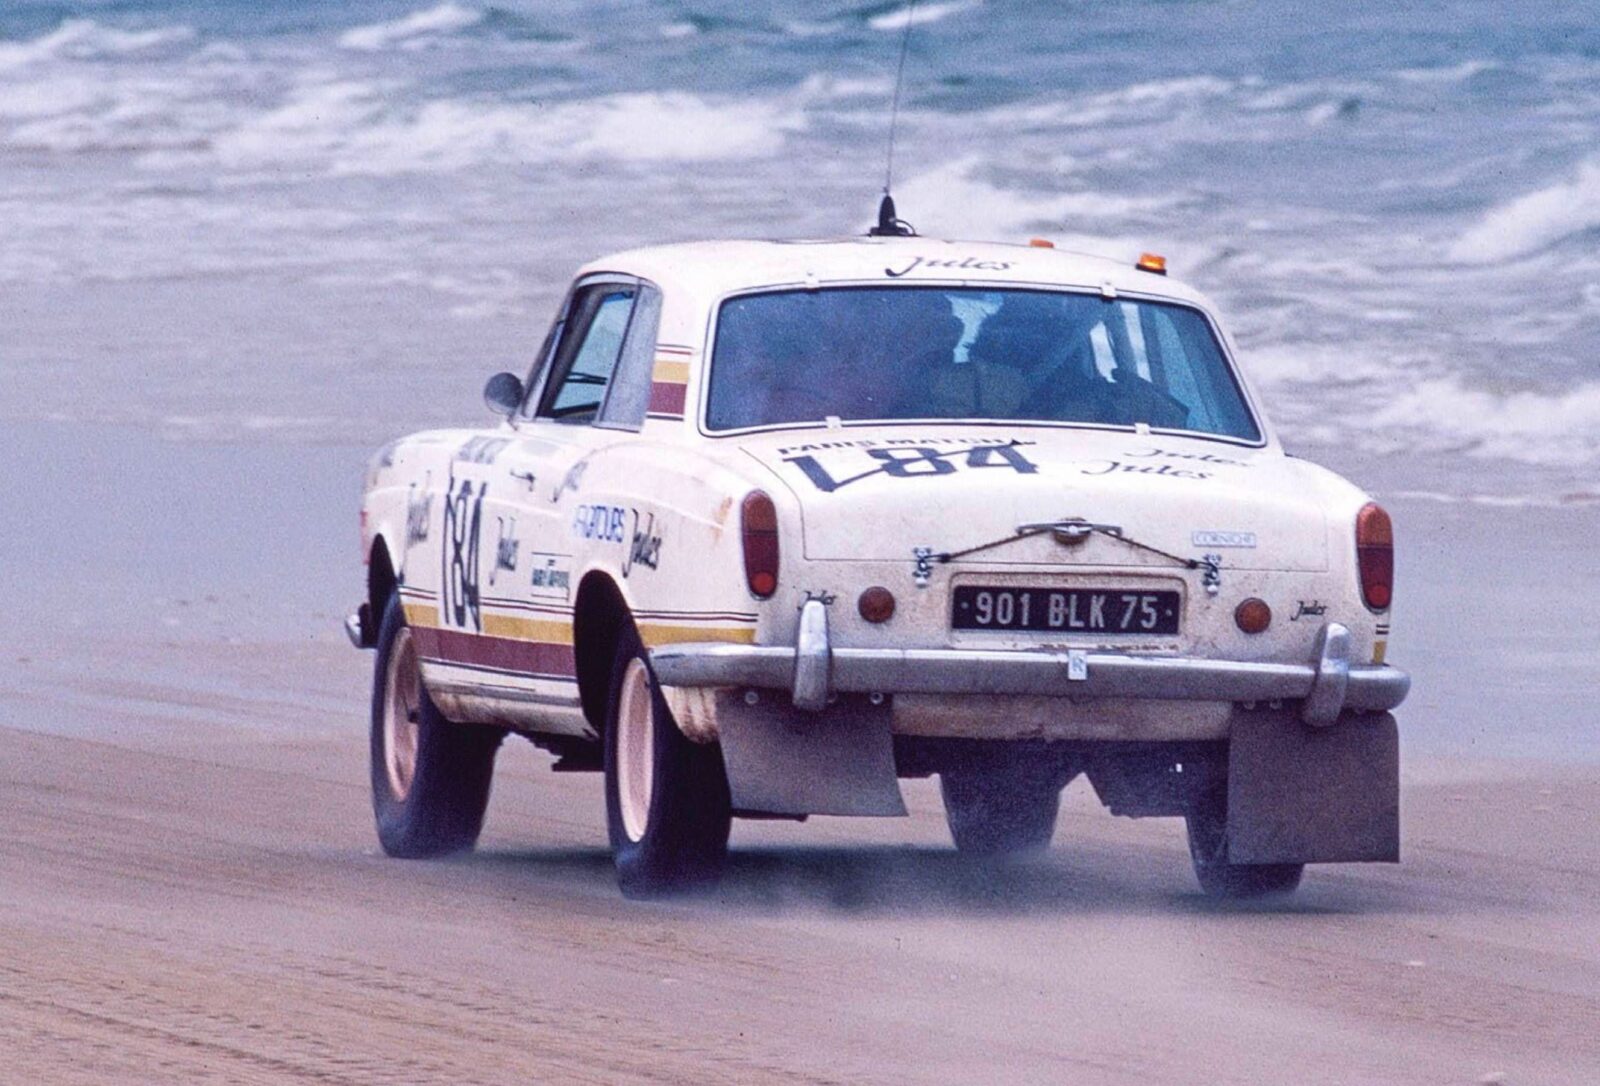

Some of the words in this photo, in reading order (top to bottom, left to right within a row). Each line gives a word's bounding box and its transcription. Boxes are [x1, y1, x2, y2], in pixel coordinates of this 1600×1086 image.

[884, 256, 1016, 278] Jules
[782, 445, 1039, 493] 184
[1080, 461, 1215, 480] Jules
[975, 592, 1032, 626] 901
[1049, 593, 1106, 629] BLK
[1120, 595, 1159, 630] 75
[1290, 600, 1328, 621] Jules
